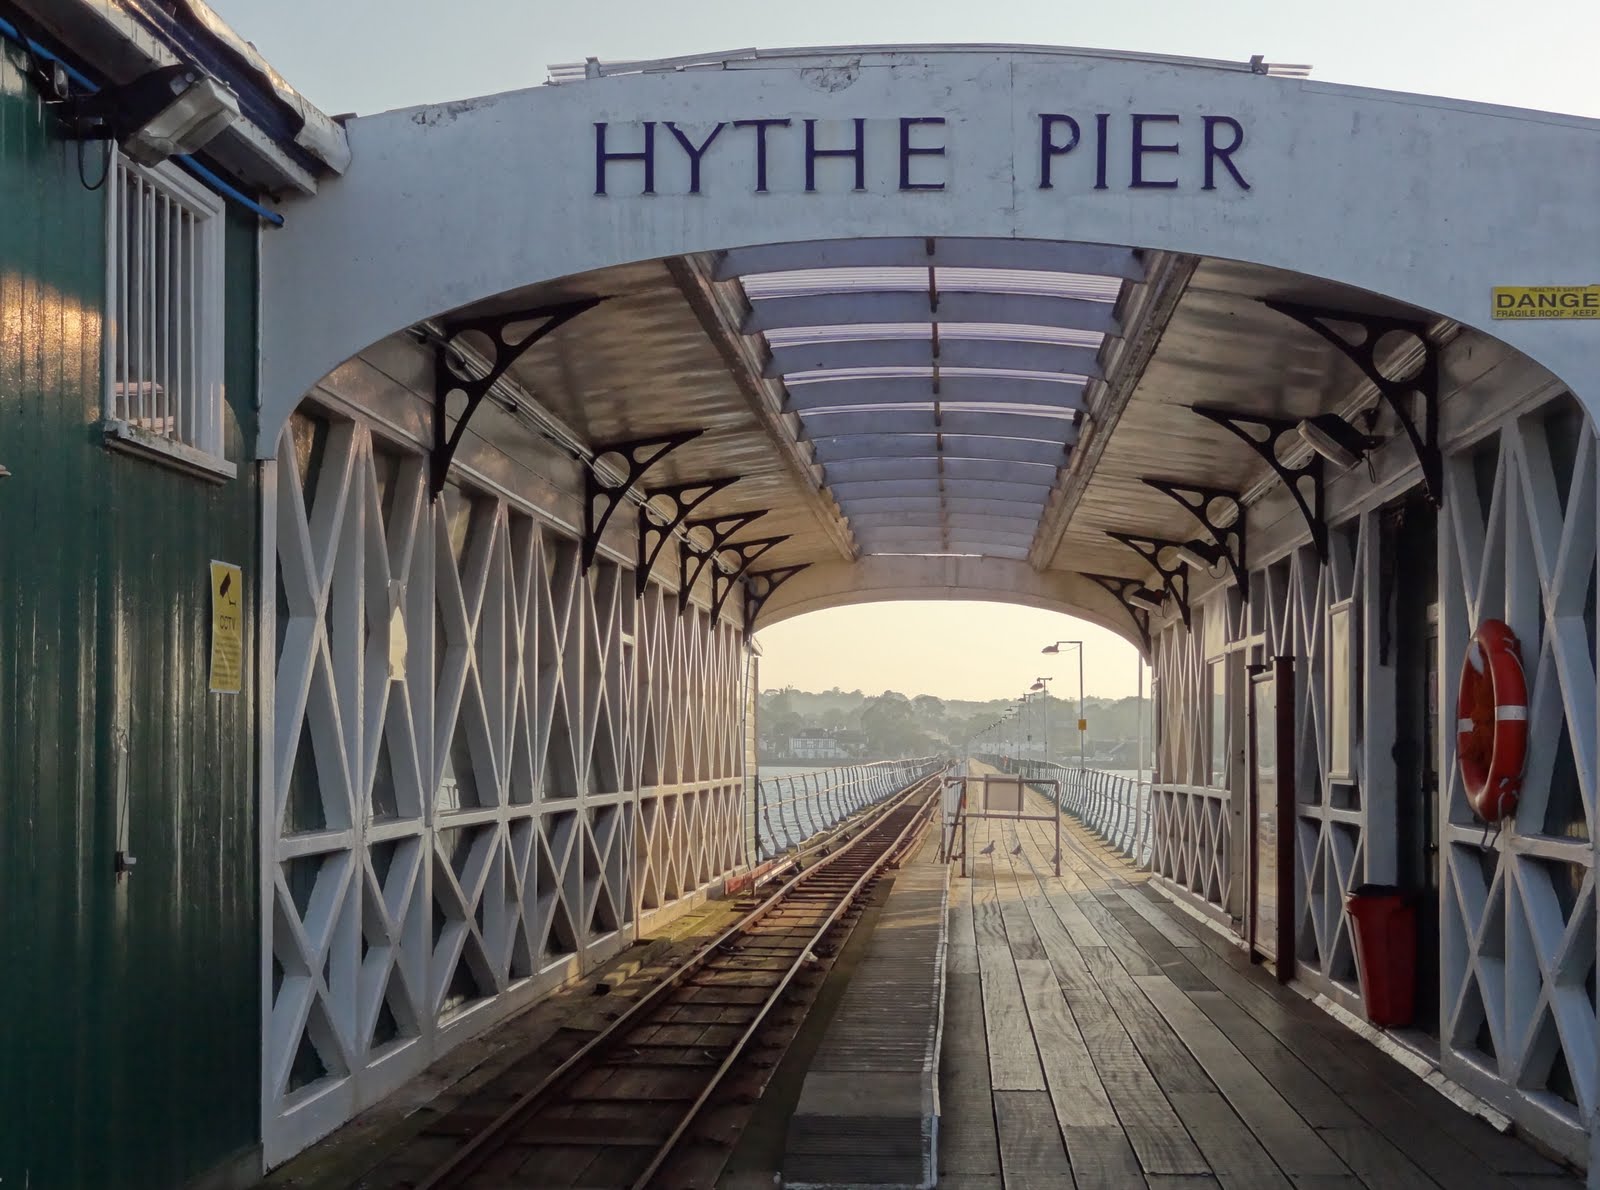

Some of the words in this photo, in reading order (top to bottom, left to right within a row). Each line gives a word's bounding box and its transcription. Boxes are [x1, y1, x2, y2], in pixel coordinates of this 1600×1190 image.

[594, 116, 949, 195] HYTHE
[1037, 112, 1251, 191] PIER
[1496, 310, 1536, 318] FRAGILE
[1538, 309, 1565, 317] ROOF
[1572, 309, 1598, 317] KEEP
